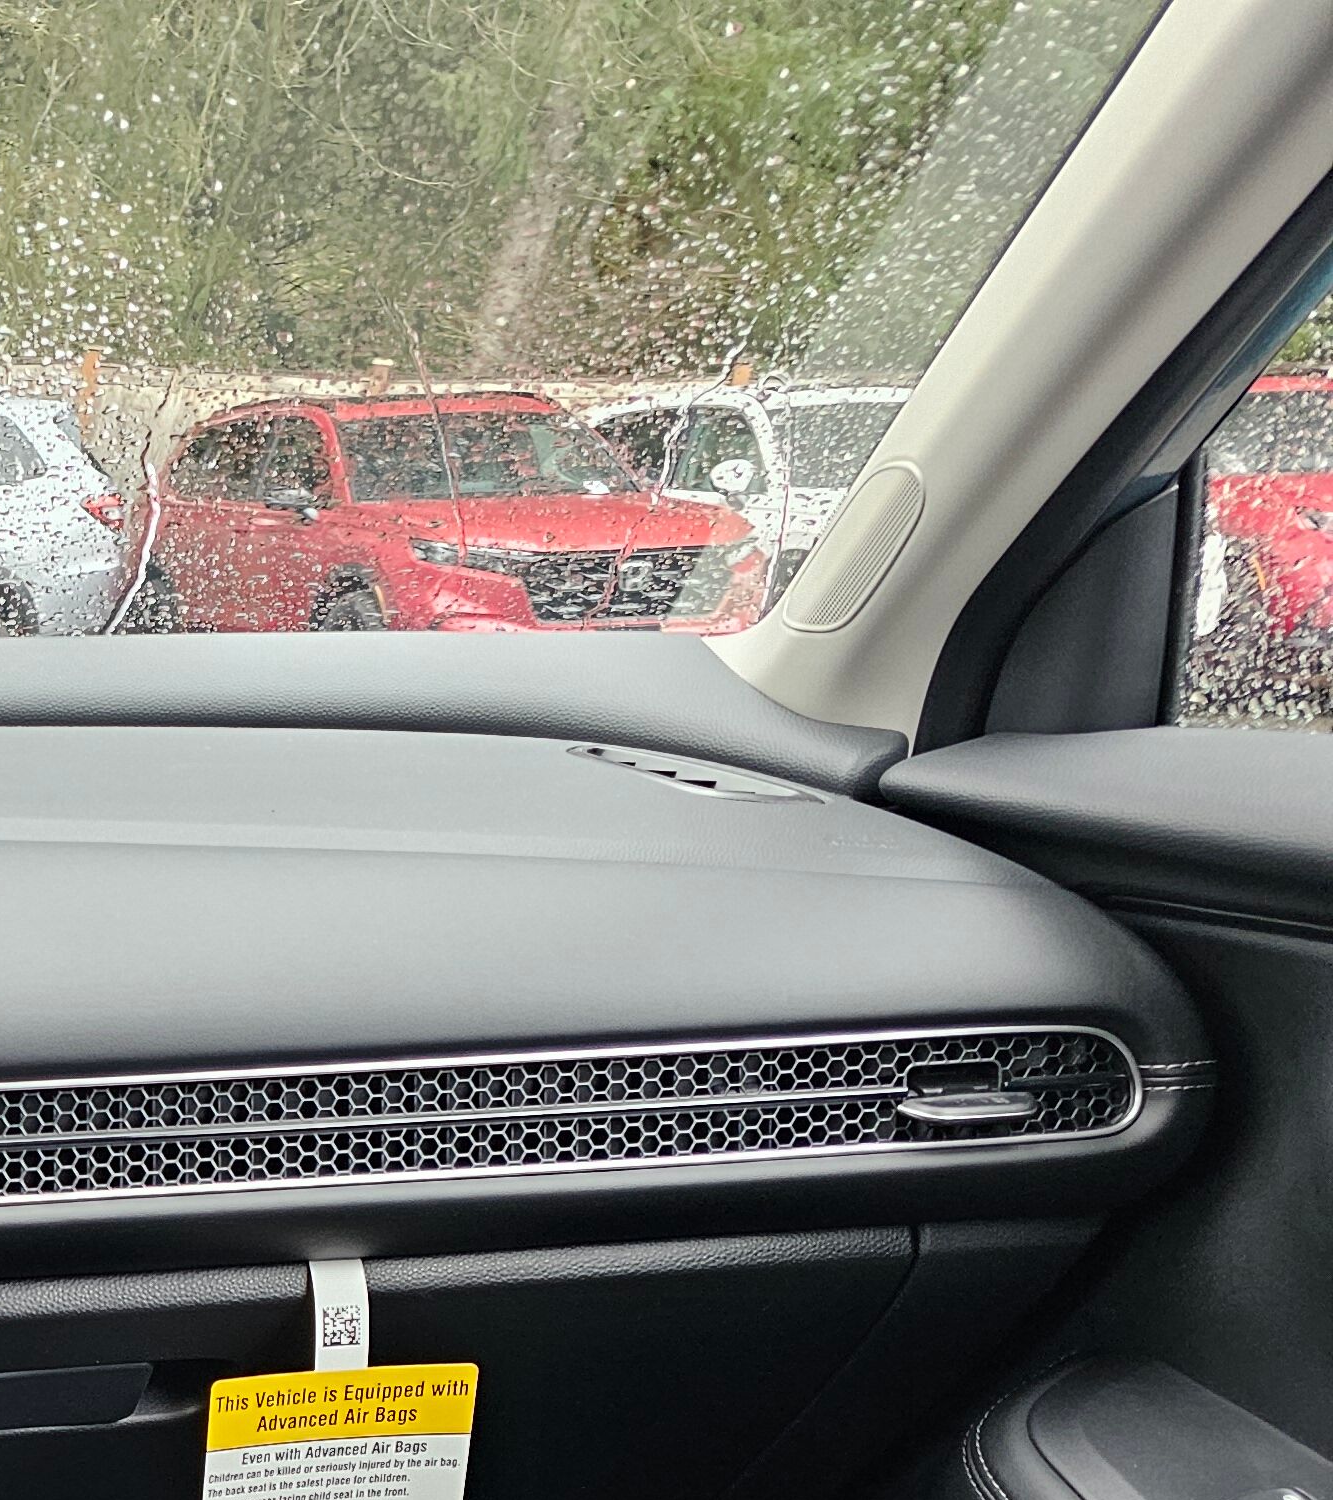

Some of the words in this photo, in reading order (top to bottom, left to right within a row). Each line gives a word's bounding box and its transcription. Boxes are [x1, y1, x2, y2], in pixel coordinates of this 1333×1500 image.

[216, 1395, 248, 1412] This
[256, 1388, 316, 1408] Vehicle
[324, 1387, 337, 1402] is
[344, 1381, 424, 1403] Equipped
[432, 1380, 468, 1396] with
[257, 1410, 338, 1432] Advanced
[344, 1408, 369, 1424] Air
[375, 1407, 417, 1425] Bags
[242, 1453, 270, 1464] Even
[275, 1448, 300, 1460] with
[305, 1443, 367, 1458] Advanced
[372, 1442, 391, 1454] Air
[395, 1441, 427, 1454] Bags
[209, 1473, 243, 1483] Children
[247, 1471, 261, 1479] can
[265, 1469, 274, 1477] be
[277, 1465, 301, 1475] killed
[316, 1461, 356, 1473] seriously
[359, 1460, 391, 1471] injured
[394, 1459, 404, 1469] by
[408, 1459, 421, 1467] the
[425, 1458, 437, 1466] air
[441, 1458, 460, 1468] bag.
[208, 1489, 222, 1498] The
[225, 1486, 245, 1495] back
[248, 1484, 266, 1493] seat
[270, 1482, 276, 1490] is
[280, 1481, 293, 1489] the
[296, 1478, 323, 1488] safest
[326, 1477, 350, 1487] place
[354, 1476, 366, 1484] for
[369, 1474, 410, 1483] children.
[309, 1492, 331, 1500] child
[334, 1490, 353, 1499] seat
[356, 1489, 364, 1498] in
[368, 1489, 381, 1497] the
[385, 1488, 409, 1496] front.
